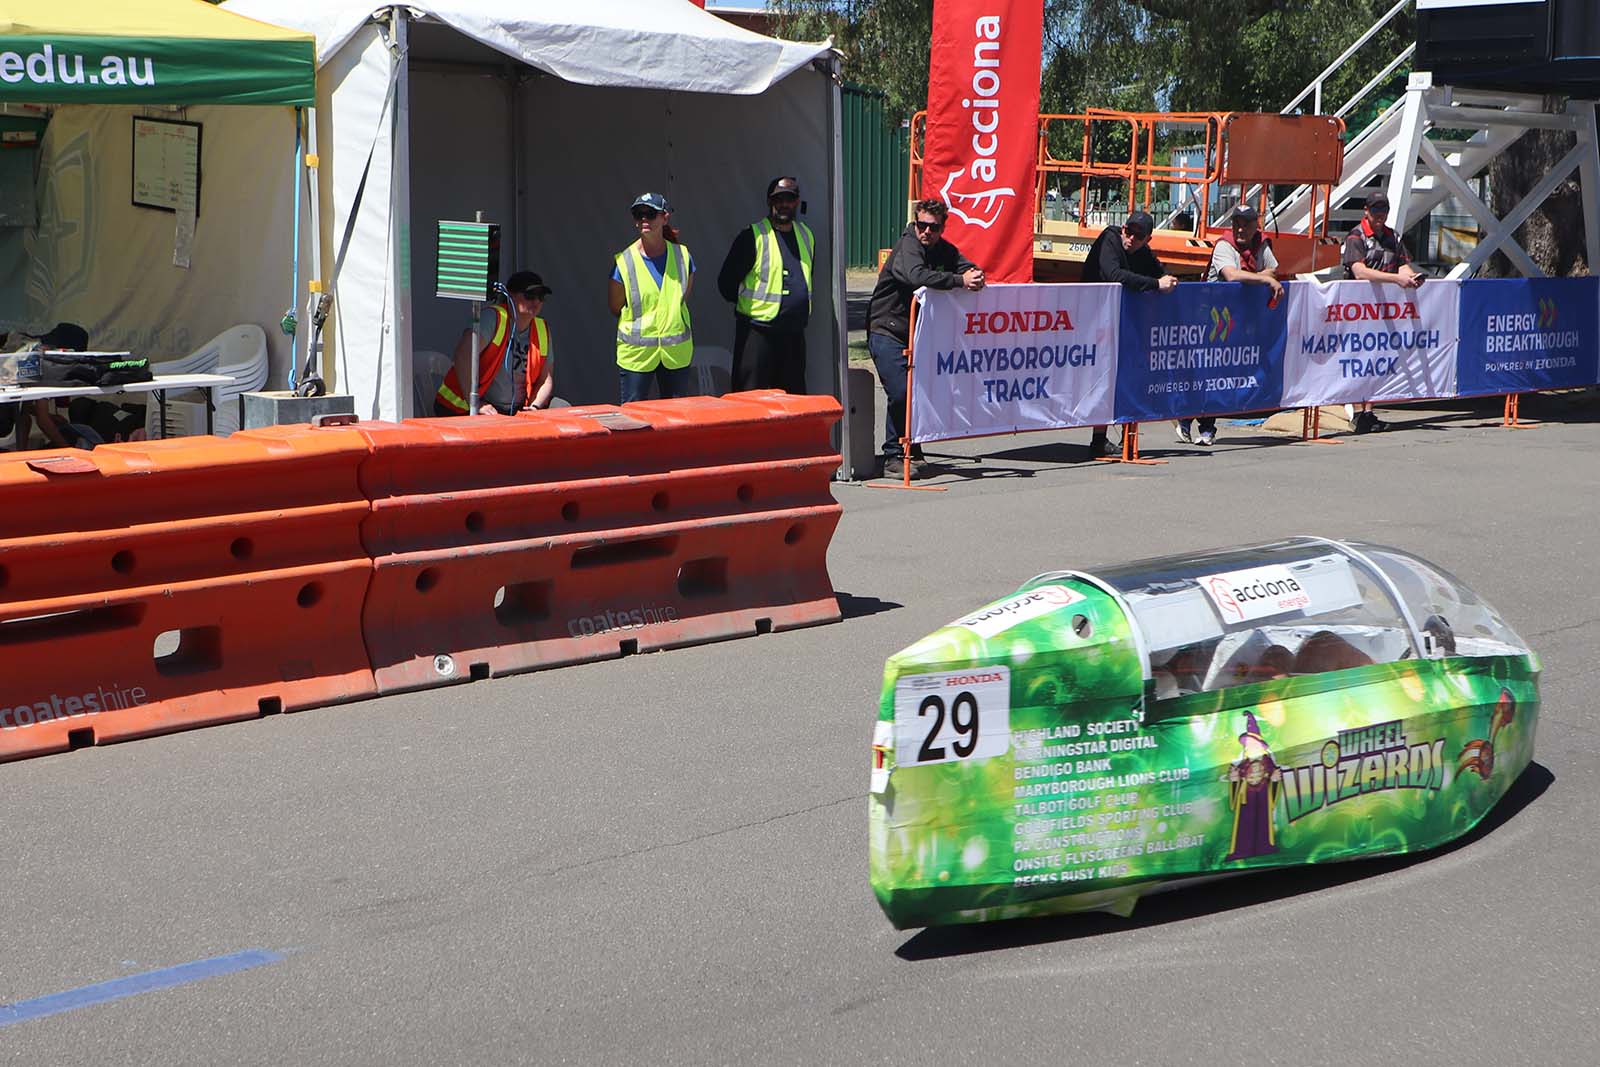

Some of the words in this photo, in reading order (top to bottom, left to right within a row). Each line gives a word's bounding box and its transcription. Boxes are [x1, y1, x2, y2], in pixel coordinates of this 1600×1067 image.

[0, 44, 156, 87] edu.au
[962, 15, 1001, 183] acciona
[964, 310, 1074, 335] HONDA
[1324, 302, 1421, 323] HONDA
[1487, 313, 1537, 333] ENERGY
[1150, 324, 1206, 347] ENERGY
[1301, 330, 1440, 355] MARYBOROUGH
[1486, 331, 1580, 353] BREAKTHROUGH
[936, 344, 1097, 376] MARYBOROUGH
[1149, 345, 1261, 372] BREAKTHROUGH
[1339, 357, 1400, 378] TRACK
[1485, 361, 1523, 373] POWERED
[1525, 360, 1534, 370] BY
[1535, 356, 1577, 370] HONDA
[983, 376, 1050, 403] TRACK
[1148, 381, 1191, 395] POWERED
[1192, 380, 1204, 391] BY
[1205, 375, 1260, 392] HONDA
[1233, 575, 1302, 602] acciona
[946, 672, 1003, 687] HONDA
[917, 691, 979, 762] 29
[1087, 719, 1139, 736] SOCIETY
[1338, 720, 1408, 757] WHEEL
[1110, 736, 1158, 753] DIGITAL
[1014, 762, 1073, 780] BENDIGO
[1075, 758, 1112, 773] BANK
[1014, 776, 1115, 799] MARYBOROUGH
[1117, 772, 1156, 788] LIONS
[1158, 767, 1190, 783] CLUB
[1014, 799, 1065, 817] TALBOT
[1068, 794, 1101, 811] GOLF
[1104, 791, 1139, 807] CLUB
[1162, 802, 1193, 817] CLUB
[1013, 854, 1062, 872] ONSITE
[1065, 845, 1143, 865] FLYSCREENS
[1147, 834, 1205, 854] BALLARAT
[1061, 867, 1095, 883] BUSY
